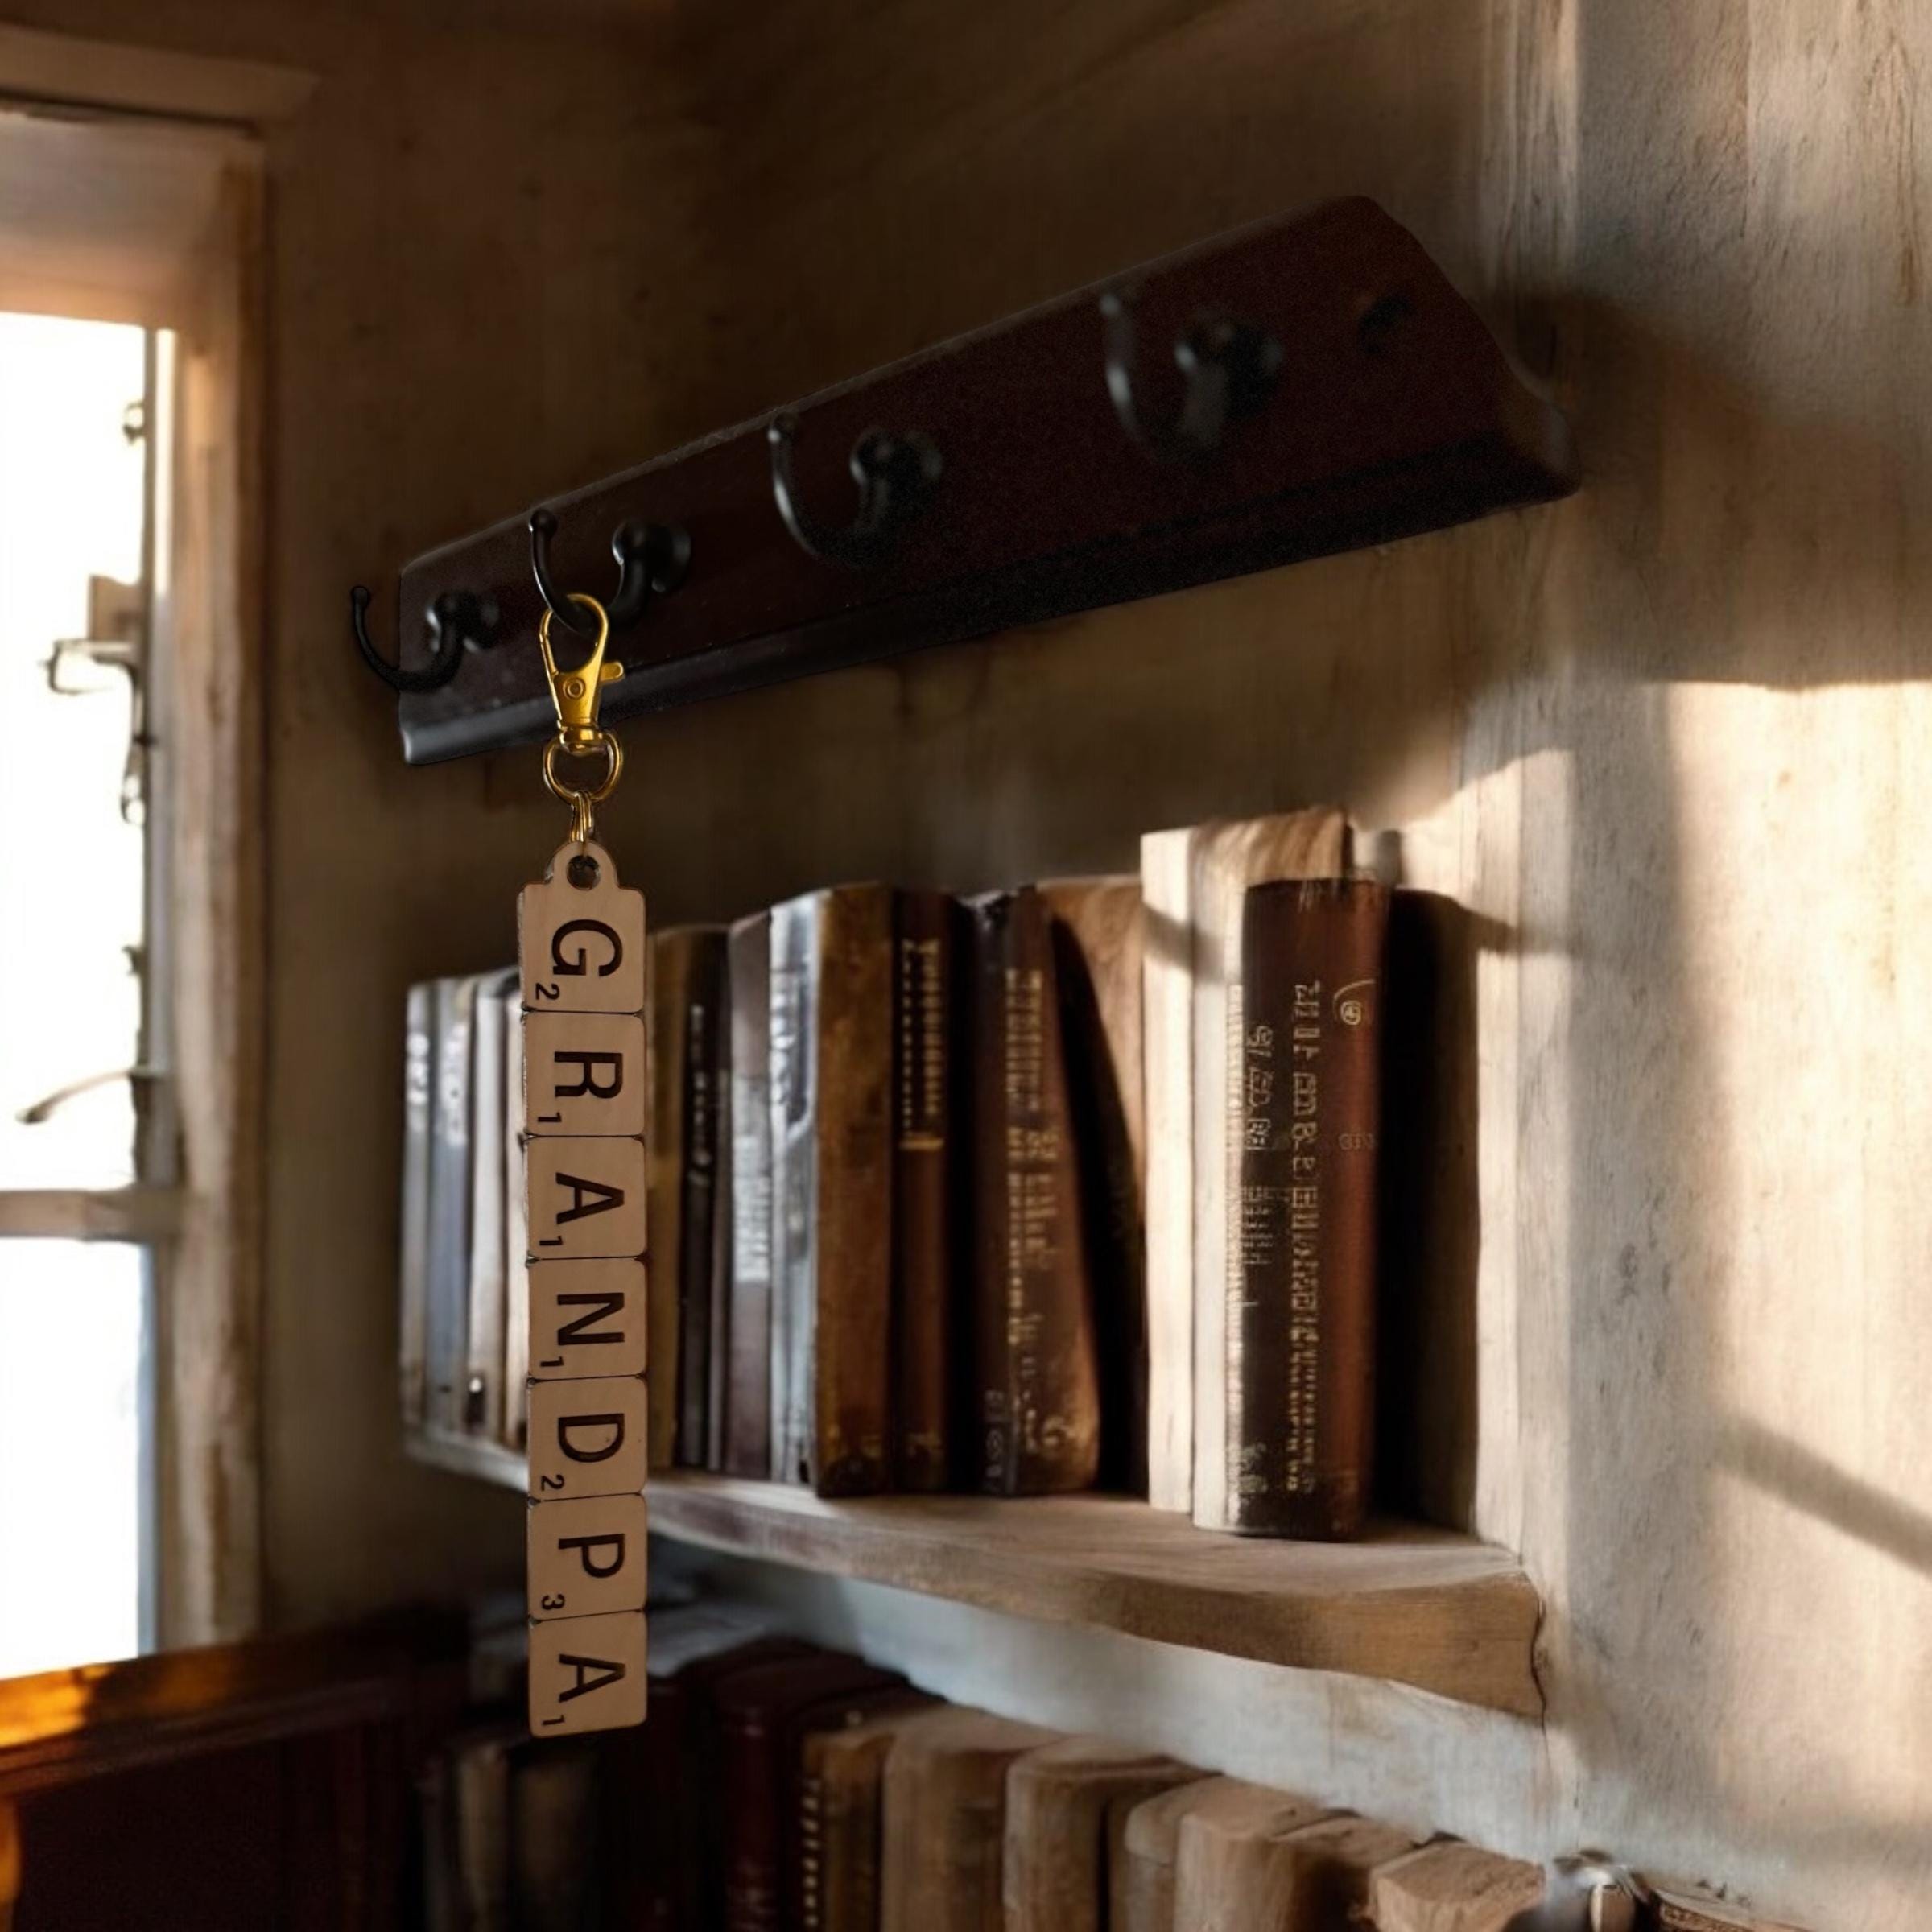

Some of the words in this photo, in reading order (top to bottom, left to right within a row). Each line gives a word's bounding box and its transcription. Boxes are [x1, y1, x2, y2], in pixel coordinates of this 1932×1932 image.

[535, 982, 560, 1001] 2
[536, 1111, 563, 1123] 1
[539, 1235, 564, 1247] 1
[551, 919, 626, 1704] GRANDPA
[539, 1356, 564, 1368] 1
[539, 1473, 565, 1492] 2
[540, 1593, 566, 1612] 3
[540, 1714, 566, 1728] 1
